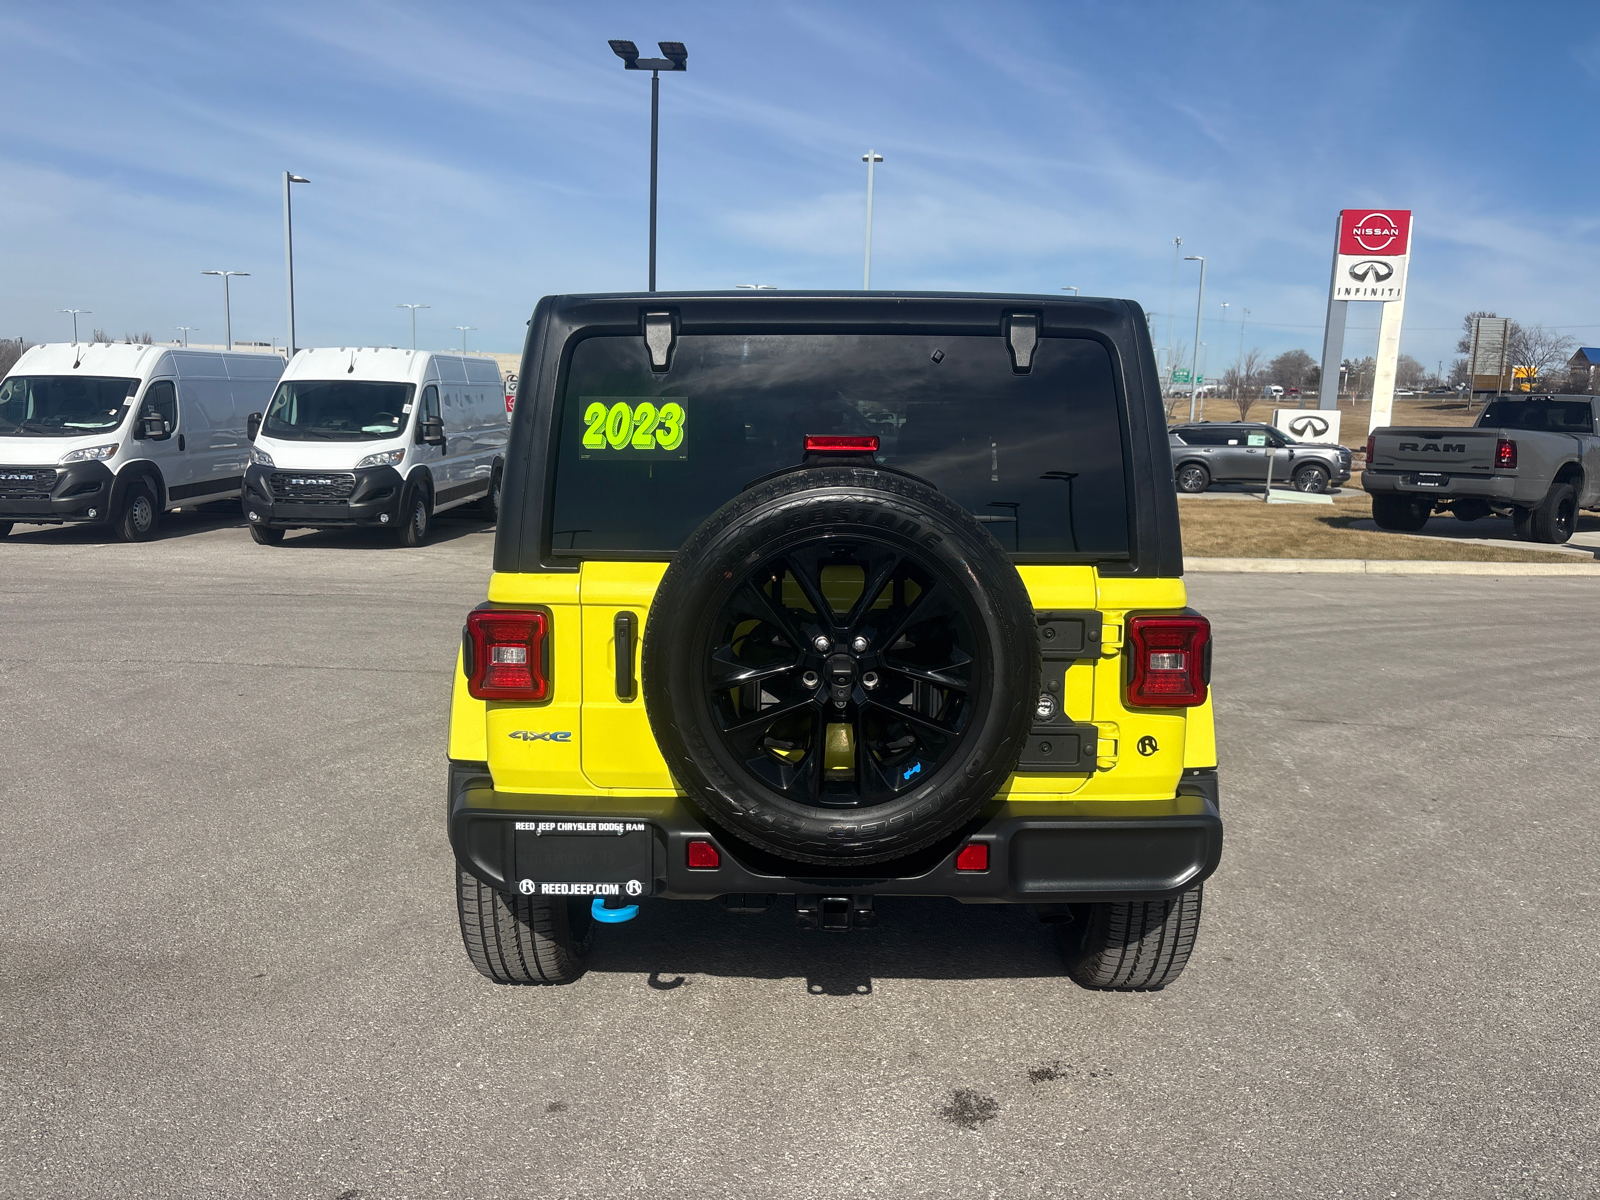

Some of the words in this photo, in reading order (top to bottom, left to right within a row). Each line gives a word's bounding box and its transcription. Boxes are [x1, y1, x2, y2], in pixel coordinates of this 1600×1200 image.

[1337, 287, 1401, 297] INFINITI
[582, 401, 686, 450] 2023
[1398, 442, 1466, 453] RAM
[707, 505, 943, 588] BRIDGESTONE
[819, 746, 988, 840] DUELER
[515, 822, 535, 831] REED
[537, 822, 555, 831] JEEP
[557, 823, 597, 831] CHRYSLER
[599, 823, 624, 832] DODGE
[626, 823, 645, 831] RAM
[541, 884, 619, 895] REEDJEEP.COM
